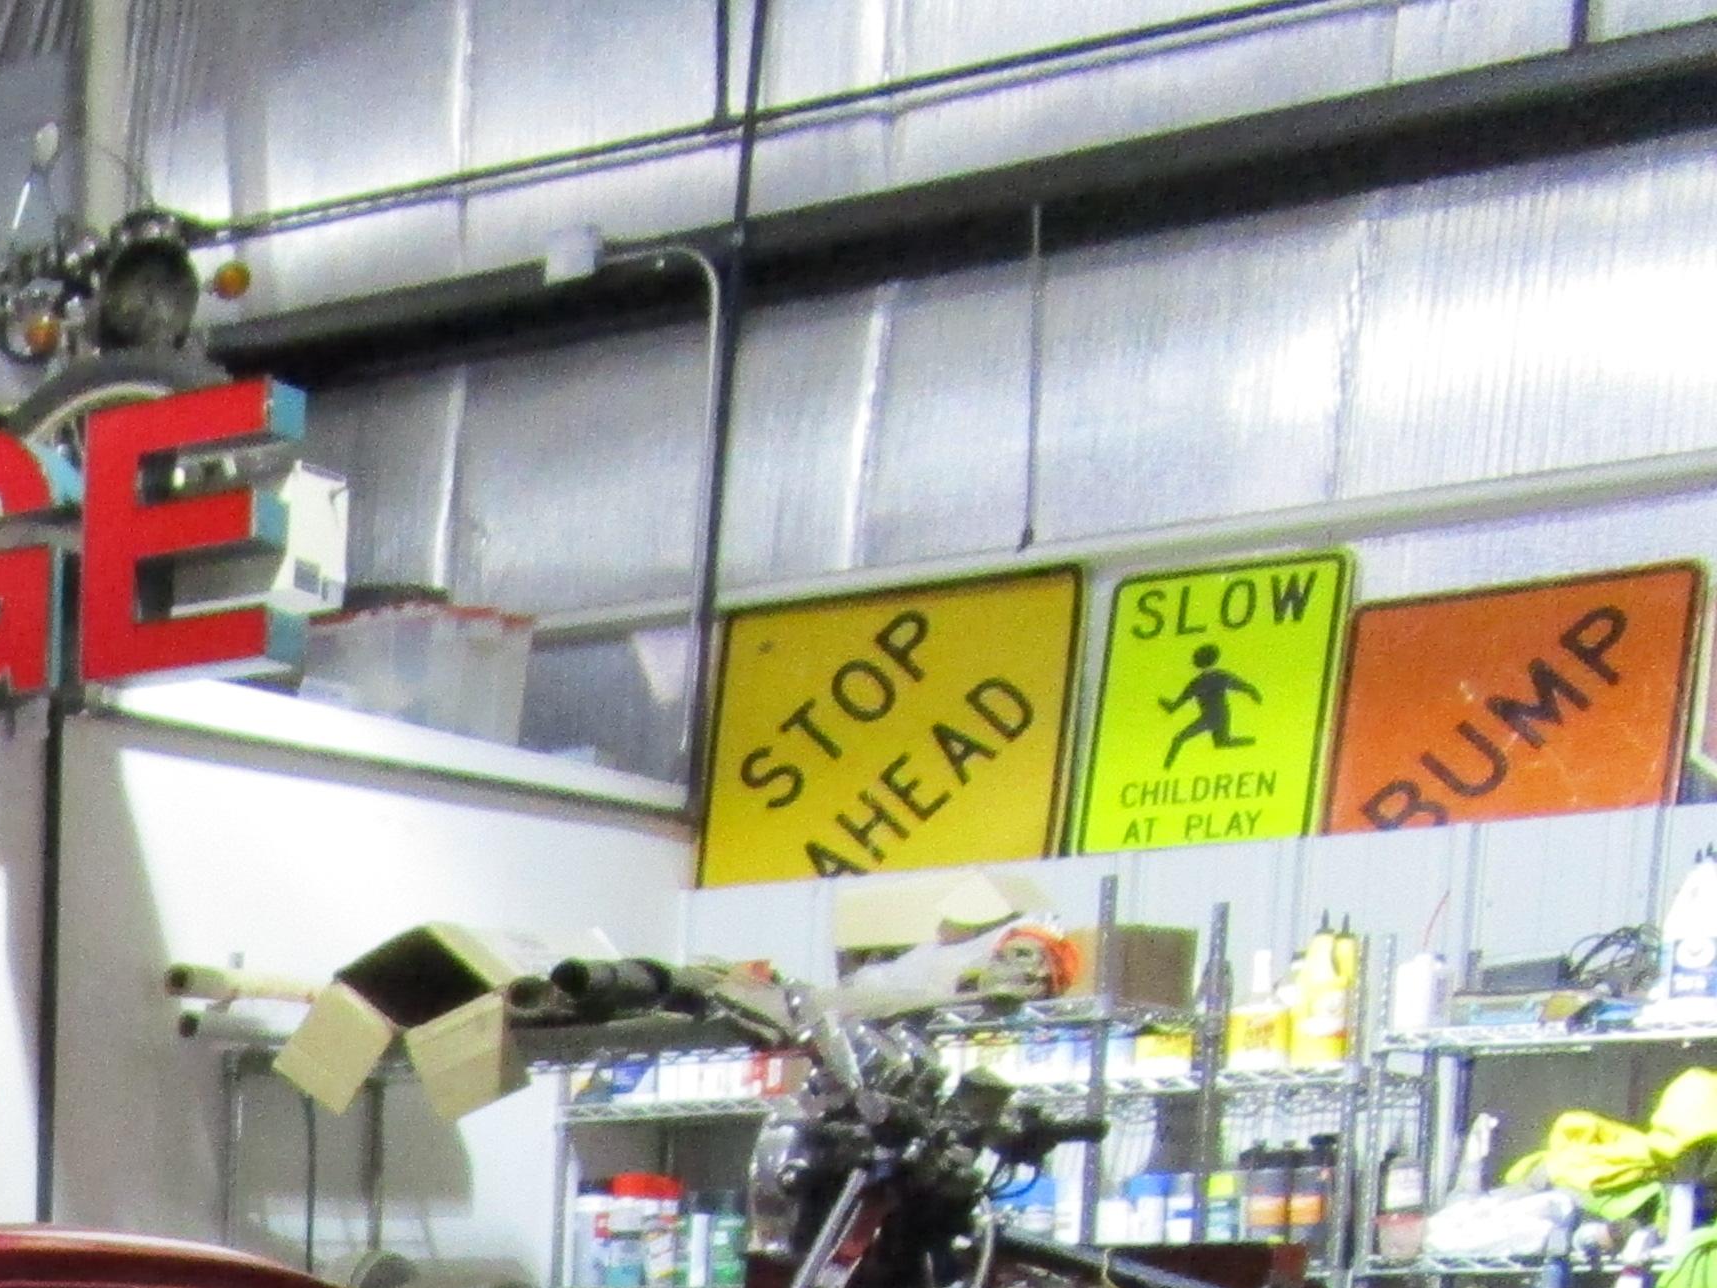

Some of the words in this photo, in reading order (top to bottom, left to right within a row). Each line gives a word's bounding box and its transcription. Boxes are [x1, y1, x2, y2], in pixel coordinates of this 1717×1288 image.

[1130, 569, 1318, 641] SLOW
[739, 609, 930, 809] STOP
[804, 676, 1035, 878] AHEAD
[1360, 605, 1628, 828] BUMP
[1119, 770, 1278, 809] CHILDREN
[1121, 816, 1160, 845] AT
[1184, 808, 1263, 841] PLAY
